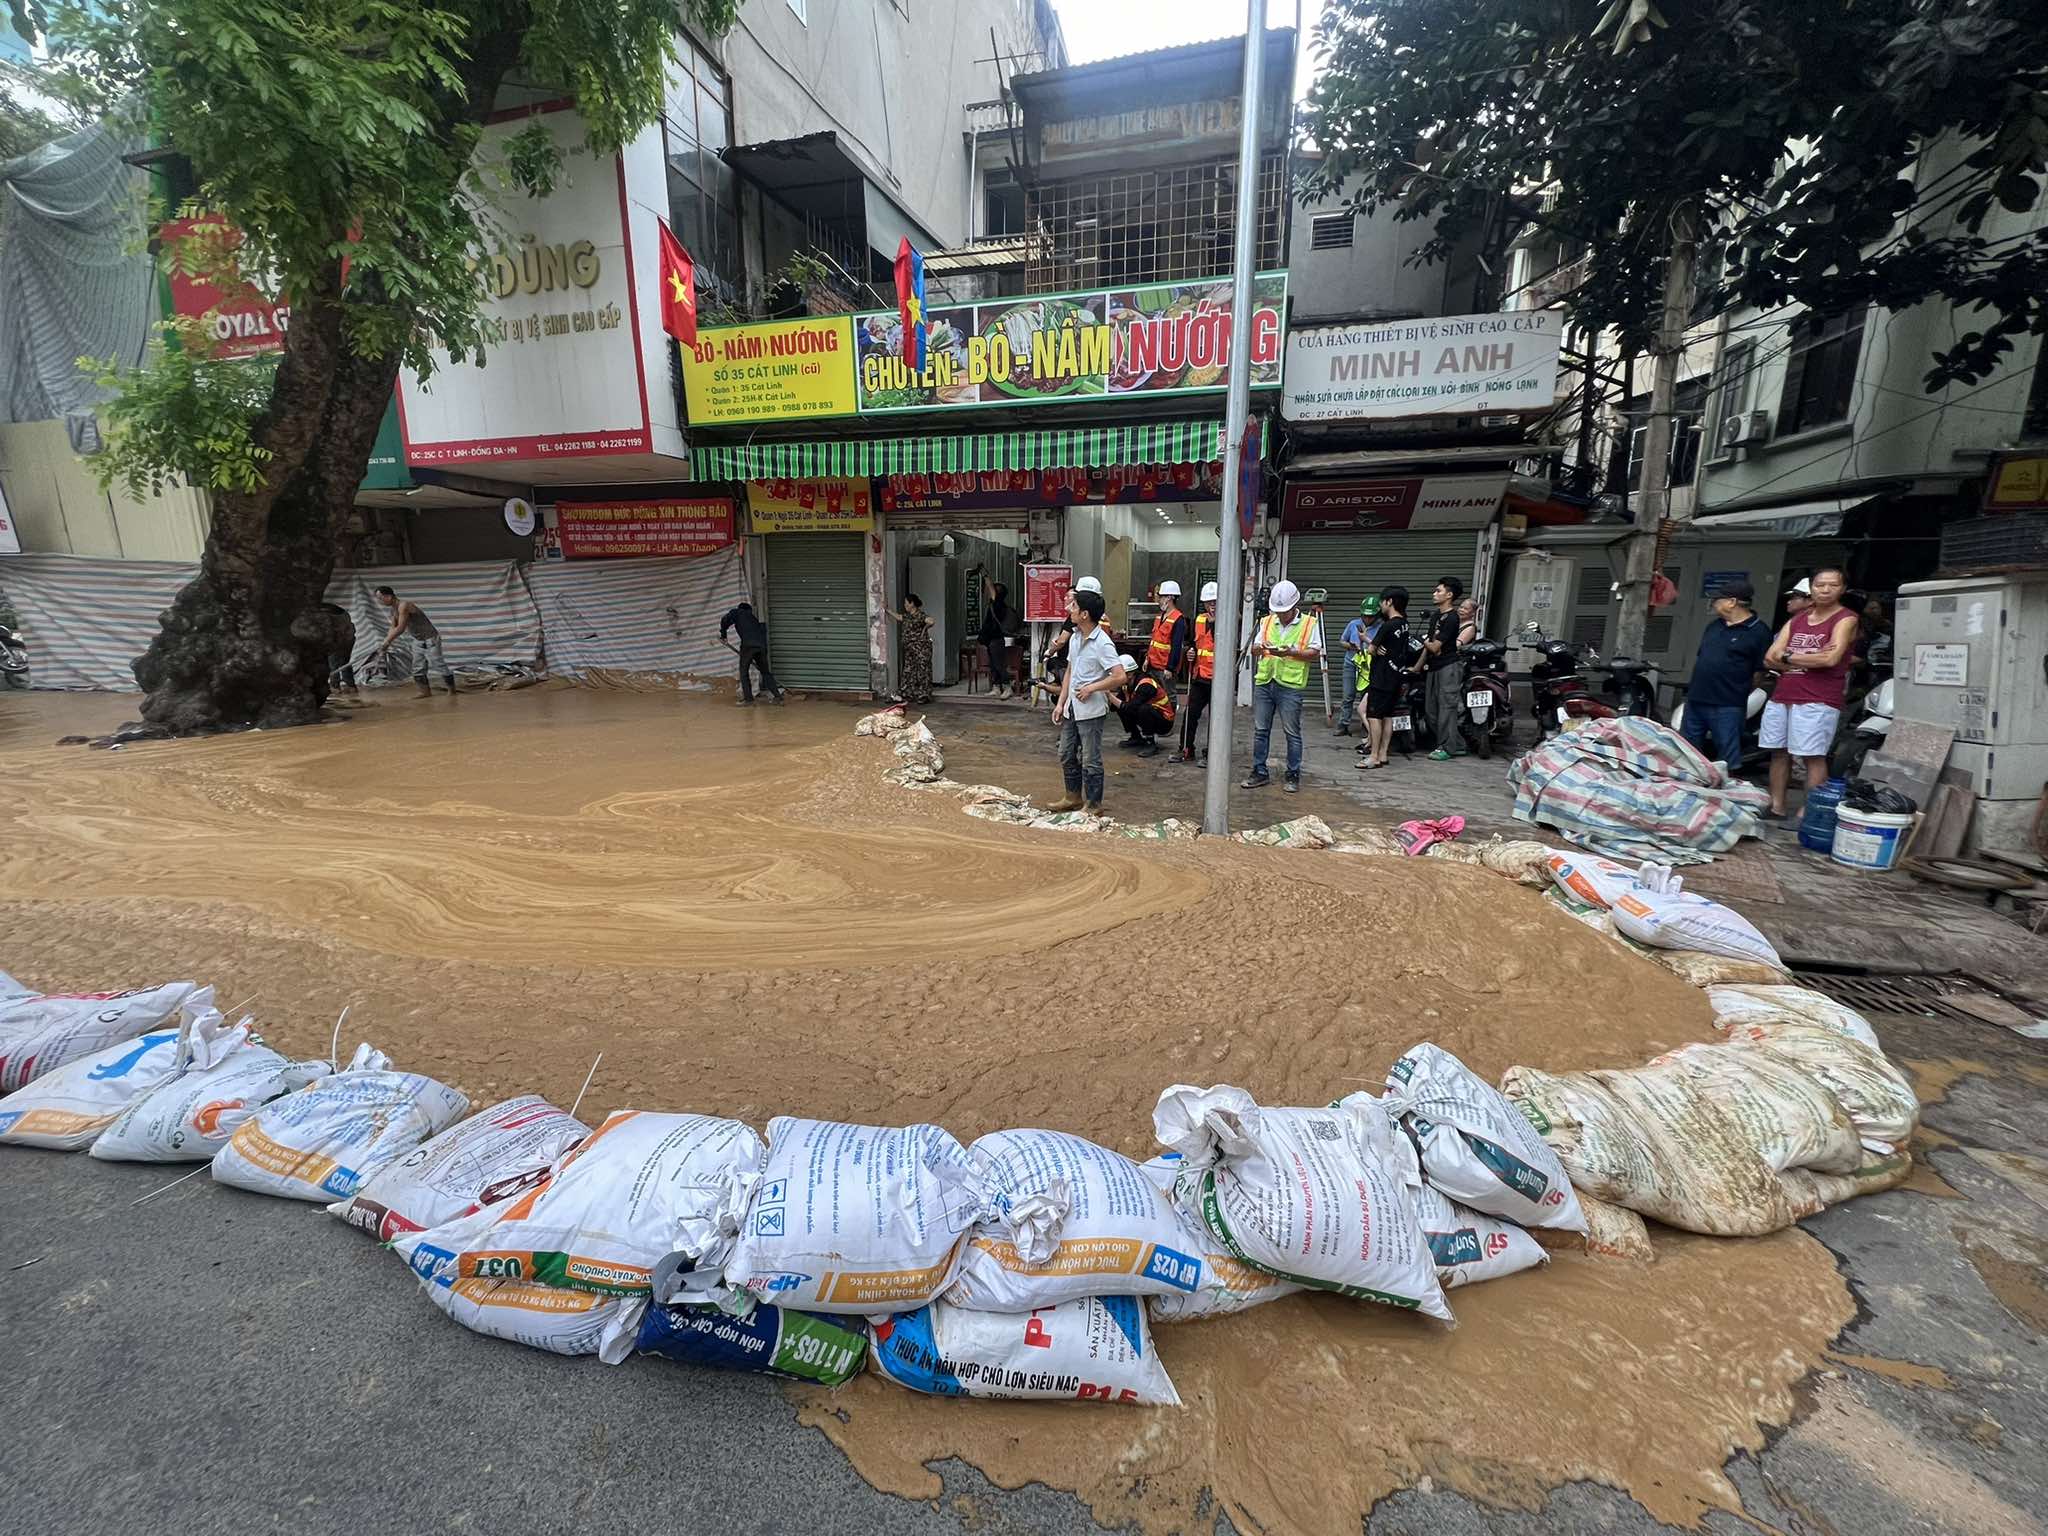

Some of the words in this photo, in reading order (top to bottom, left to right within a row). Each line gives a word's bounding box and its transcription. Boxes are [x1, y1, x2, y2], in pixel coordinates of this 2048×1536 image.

[490, 234, 600, 300] DŨNG
[207, 312, 271, 340] OYAL
[543, 314, 570, 336] SINH
[572, 311, 595, 331] CAO
[598, 302, 622, 330] CẤP
[1441, 322, 1475, 338] SINH
[1479, 319, 1507, 334] CAO
[1514, 314, 1546, 330] CẤP
[770, 326, 838, 357] NƯỚNG
[714, 364, 729, 382] SỐ
[731, 367, 745, 380] 35
[748, 363, 770, 379] CÁT
[772, 364, 798, 377] LINH
[801, 362, 821, 376] (cũ)
[1329, 350, 1420, 382] MINH
[1434, 343, 1514, 374] ANH
[740, 383, 750, 392] 35
[767, 381, 783, 390] Linh
[780, 391, 796, 400] Linh
[562, 508, 613, 520] SHOWROOM
[659, 506, 675, 518] XIN
[677, 505, 707, 518] THÔNG
[1322, 495, 1397, 505] ARISTON
[1421, 498, 1461, 509] MINH
[1463, 497, 1498, 508] ANH
[1154, 1254, 1180, 1278] 02S
[567, 1299, 581, 1308] KG
[1090, 1305, 1101, 1332] XUẤT
[714, 1327, 740, 1344] HỢP
[739, 1334, 766, 1354] HỖN
[1087, 1335, 1098, 1358] SẢN
[893, 1335, 919, 1362] THỨC
[958, 1362, 980, 1383] HỢP
[981, 1366, 1003, 1386] CHO
[1005, 1370, 1027, 1391] LỢN
[1029, 1371, 1054, 1390] SIÊU
[1055, 1375, 1079, 1394] NẠC
